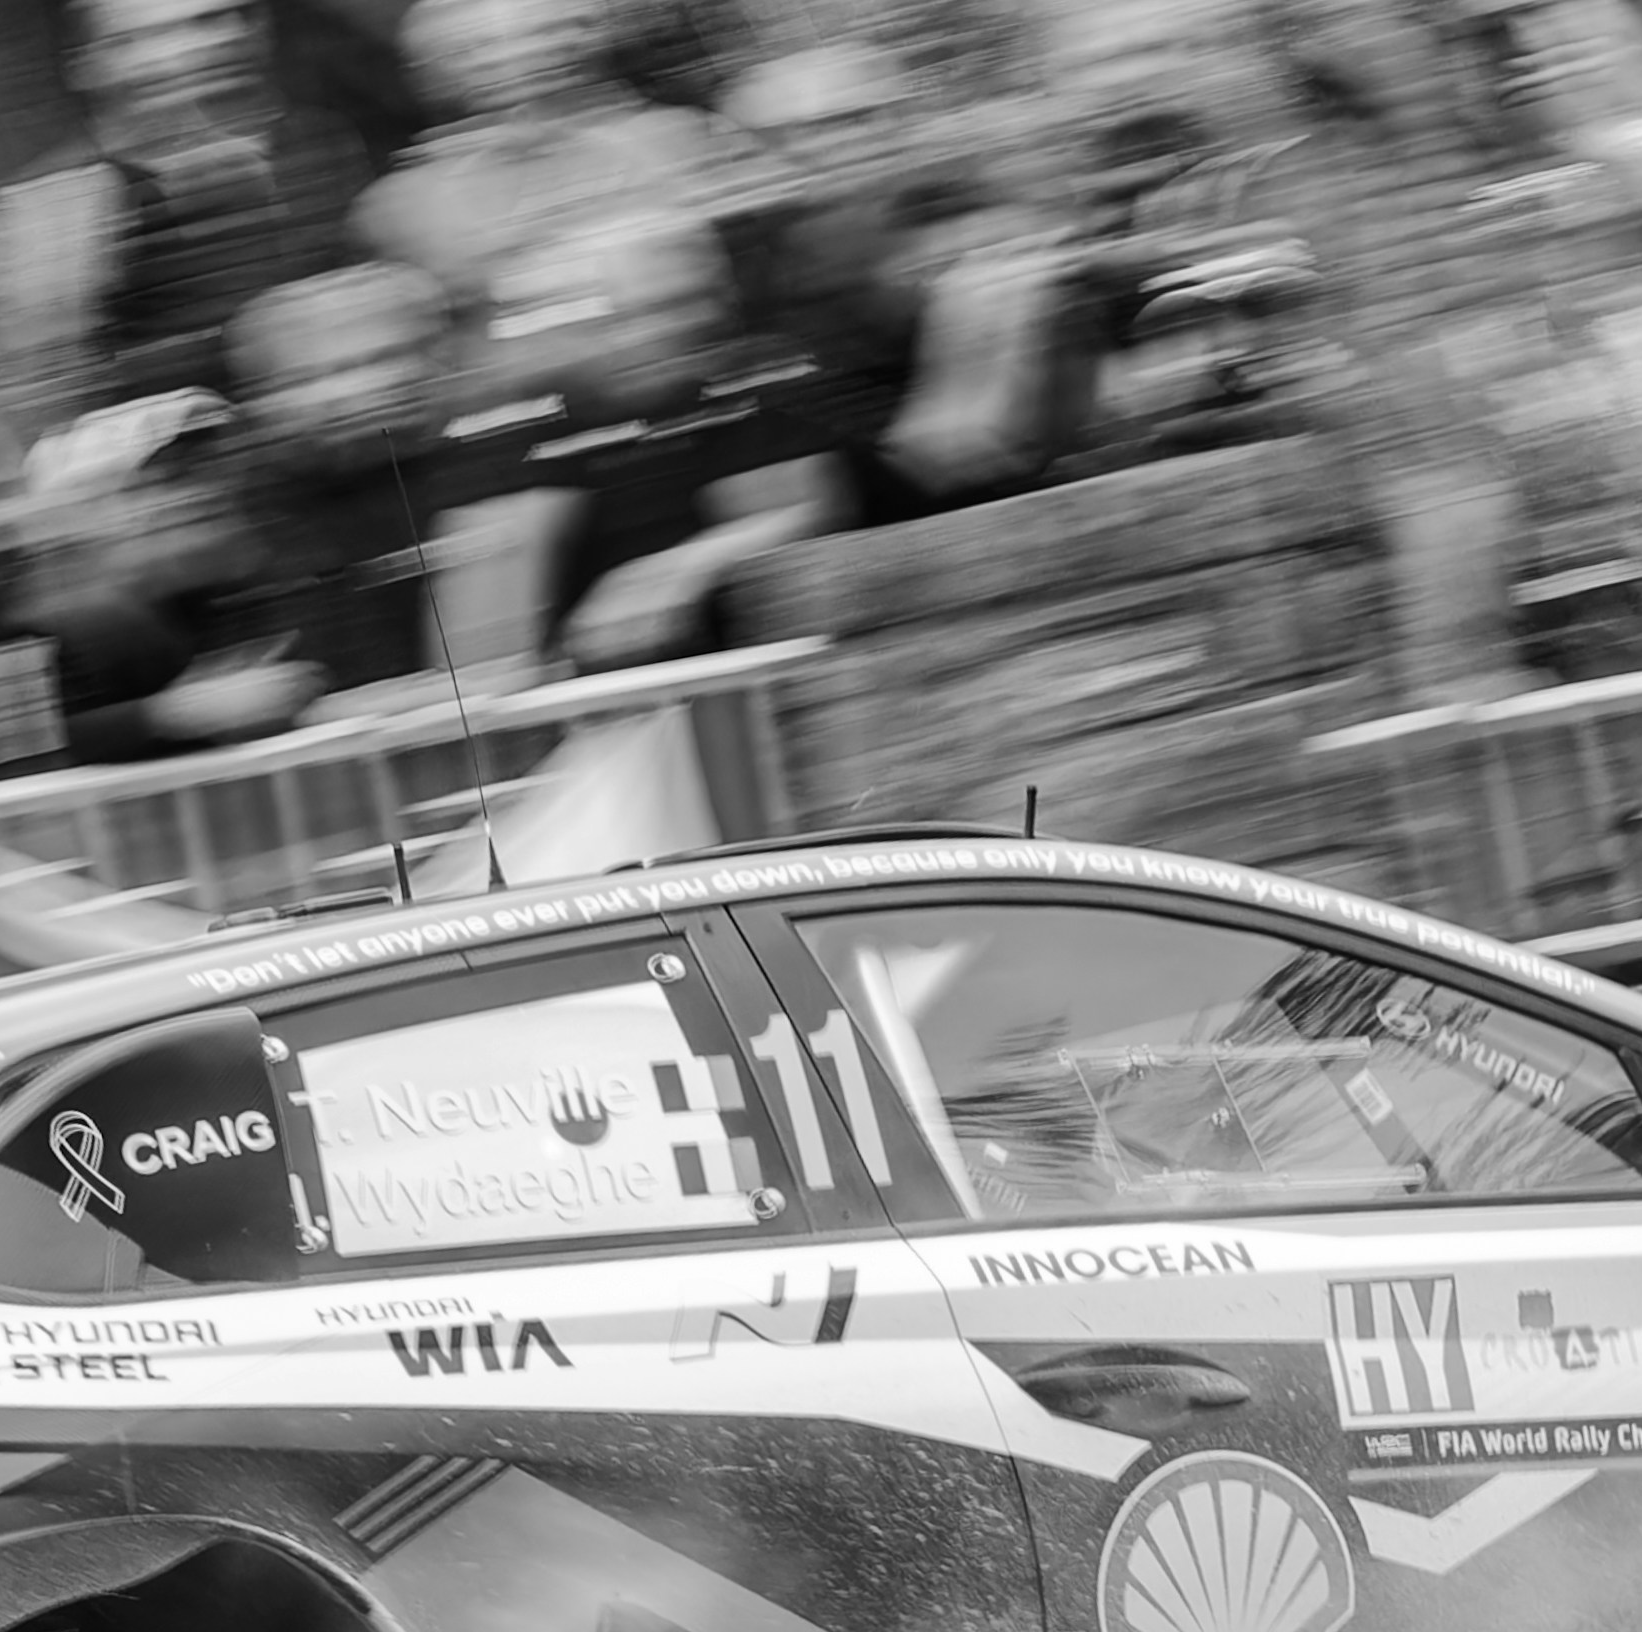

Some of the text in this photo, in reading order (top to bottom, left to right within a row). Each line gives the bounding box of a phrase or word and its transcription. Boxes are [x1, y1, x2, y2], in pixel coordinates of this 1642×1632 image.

[303, 940, 357, 970] let
[357, 915, 490, 957] anyone
[493, 899, 569, 931] ever
[574, 887, 640, 923] put
[637, 875, 710, 913] you
[711, 861, 825, 893] down,
[822, 850, 979, 879] because
[984, 846, 1058, 875] only
[1065, 850, 1134, 876] you
[1141, 855, 1240, 893] know
[1250, 873, 1330, 912] your
[1336, 895, 1410, 933] true
[1436, 1026, 1565, 1104] HYUNDAI
[366, 1065, 638, 1142] Neuville
[749, 1009, 892, 1190] 11
[121, 1109, 276, 1175] CRAIG
[333, 1148, 658, 1236] Wydaeghe
[969, 1241, 1255, 1288] INNOCEAN
[0, 1320, 223, 1346] HYUNDAI
[315, 1297, 474, 1325] HYUNDAI
[385, 1310, 574, 1377] WIA
[10, 1353, 170, 1382] STEEL
[1333, 1281, 1453, 1414] HY
[1438, 1429, 1478, 1458] FIA
[1480, 1427, 1547, 1456] World
[1553, 1424, 1610, 1456] Rally
